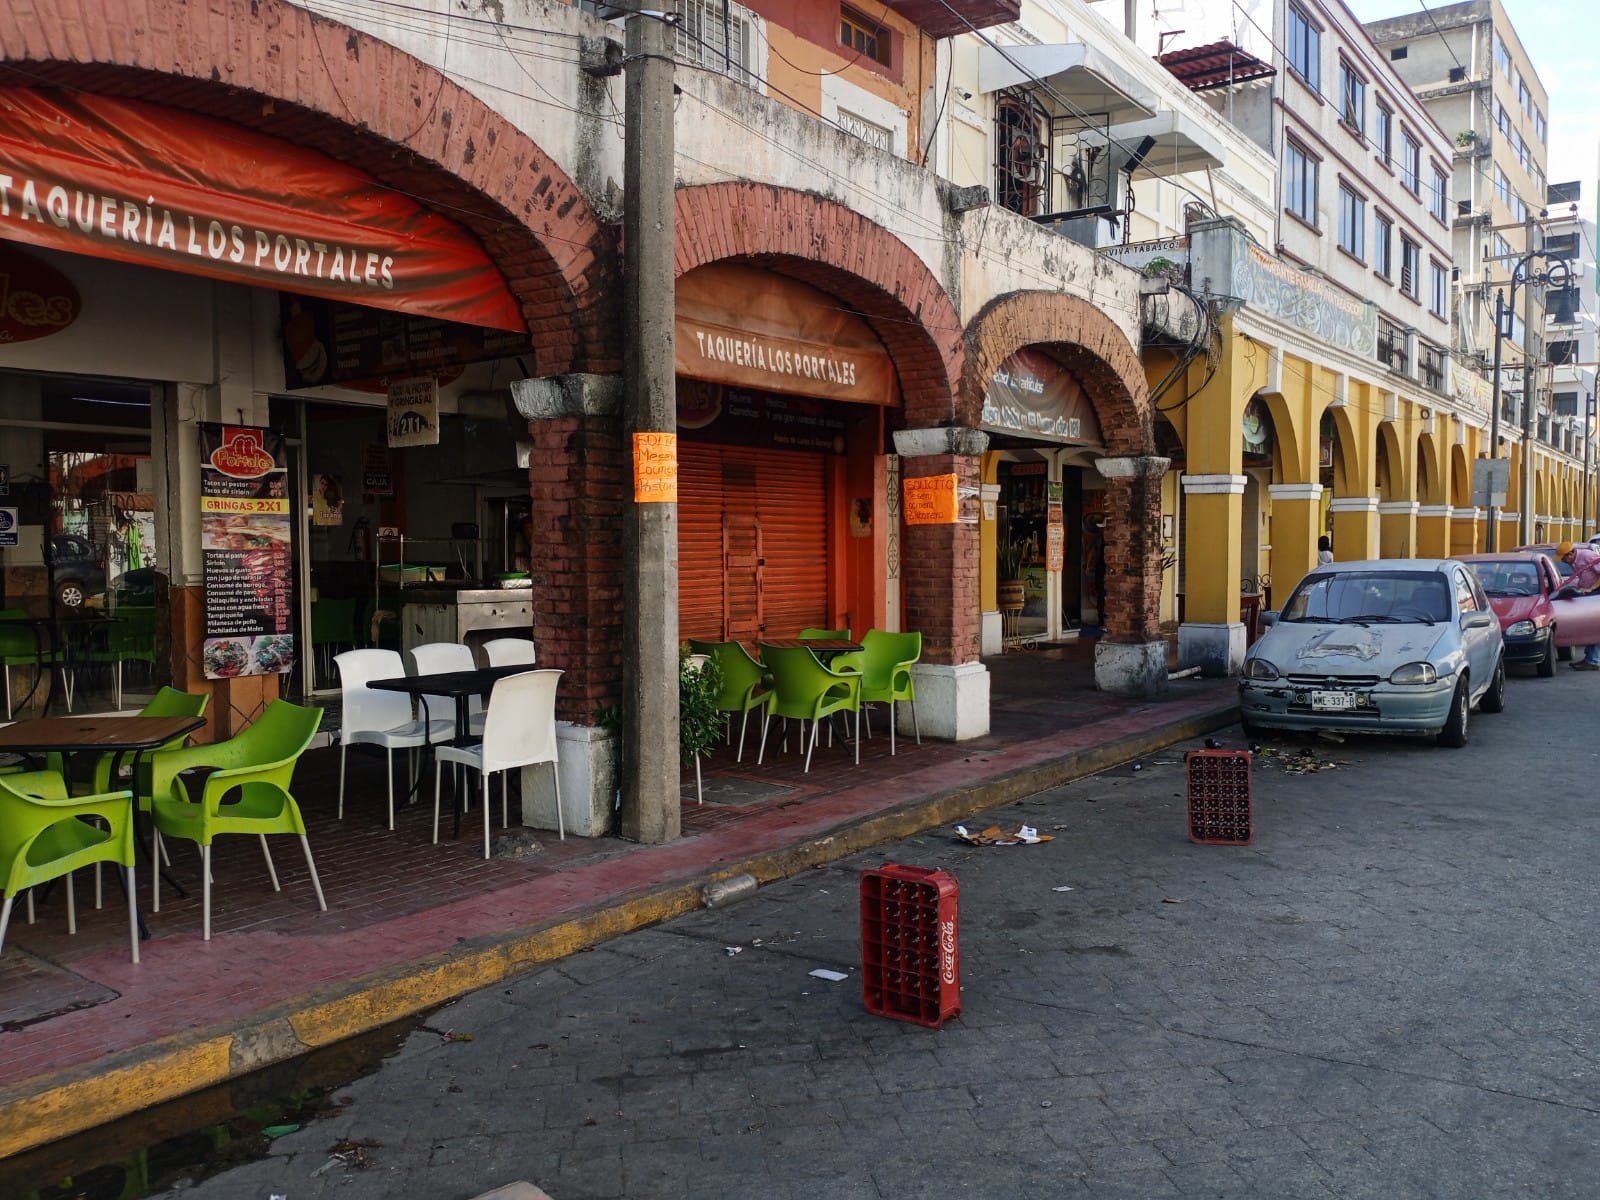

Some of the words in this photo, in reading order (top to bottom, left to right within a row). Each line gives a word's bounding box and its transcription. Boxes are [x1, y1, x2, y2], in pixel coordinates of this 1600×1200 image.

[0, 175, 177, 250] TAQUERÍA
[187, 216, 246, 263] LOS
[254, 230, 394, 290] PORTALES
[696, 331, 767, 371] TAQUERÍA
[768, 347, 793, 375] LOS
[794, 352, 857, 386] PORTALES
[207, 501, 253, 511] GRINGAS
[257, 502, 281, 512] 2X1
